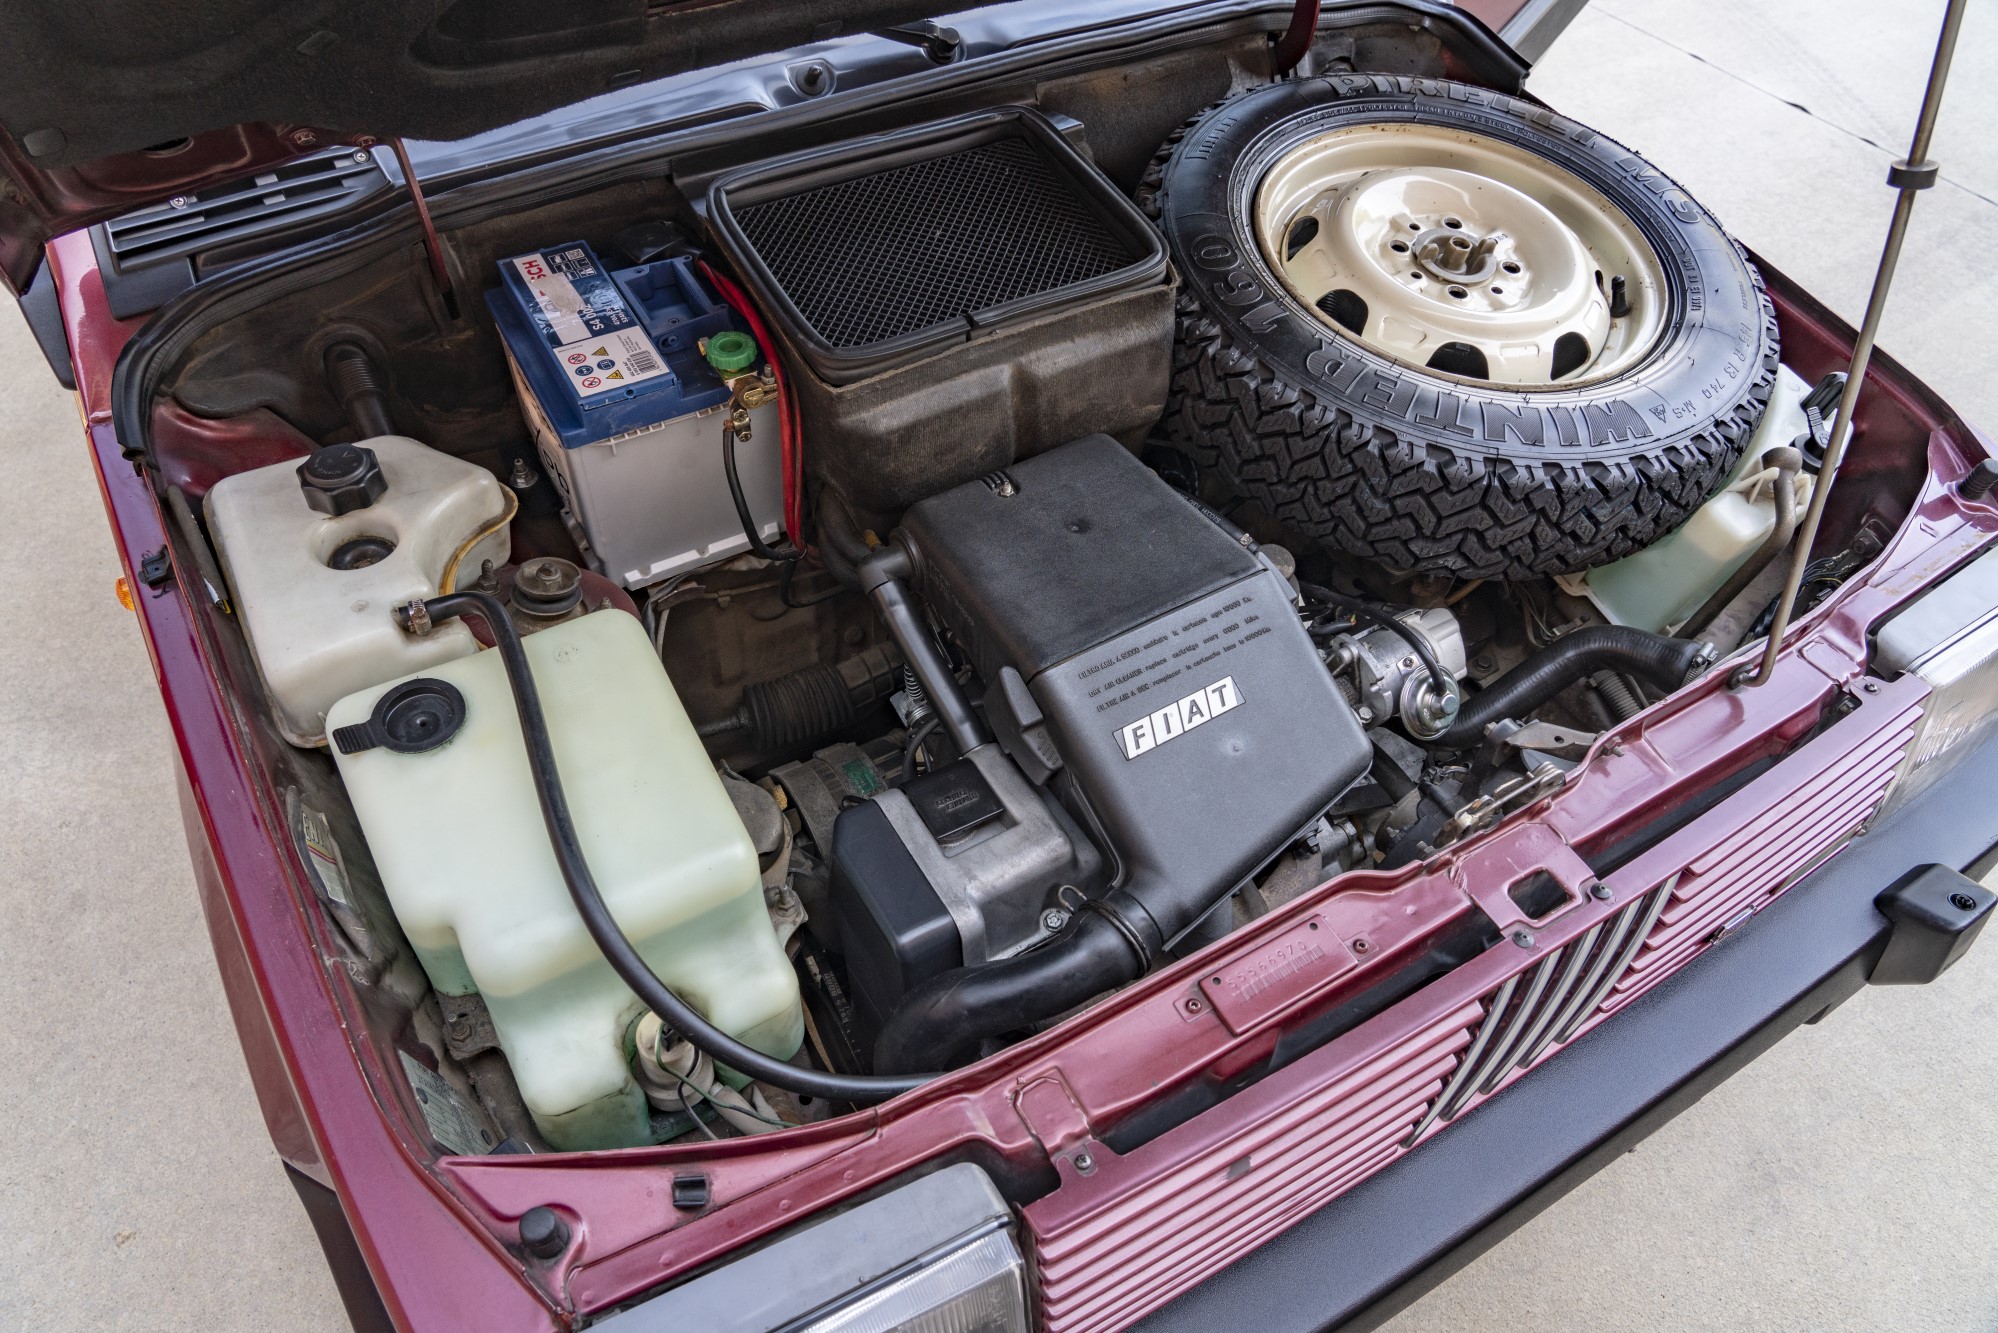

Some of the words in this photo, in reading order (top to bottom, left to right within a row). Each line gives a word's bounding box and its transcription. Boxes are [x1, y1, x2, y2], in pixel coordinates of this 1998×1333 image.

[1322, 76, 1598, 147] PIRELLI
[1304, 336, 1655, 447] WINTER
[1172, 642, 1199, 659] cartridge
[1130, 682, 1228, 751] FIAT
